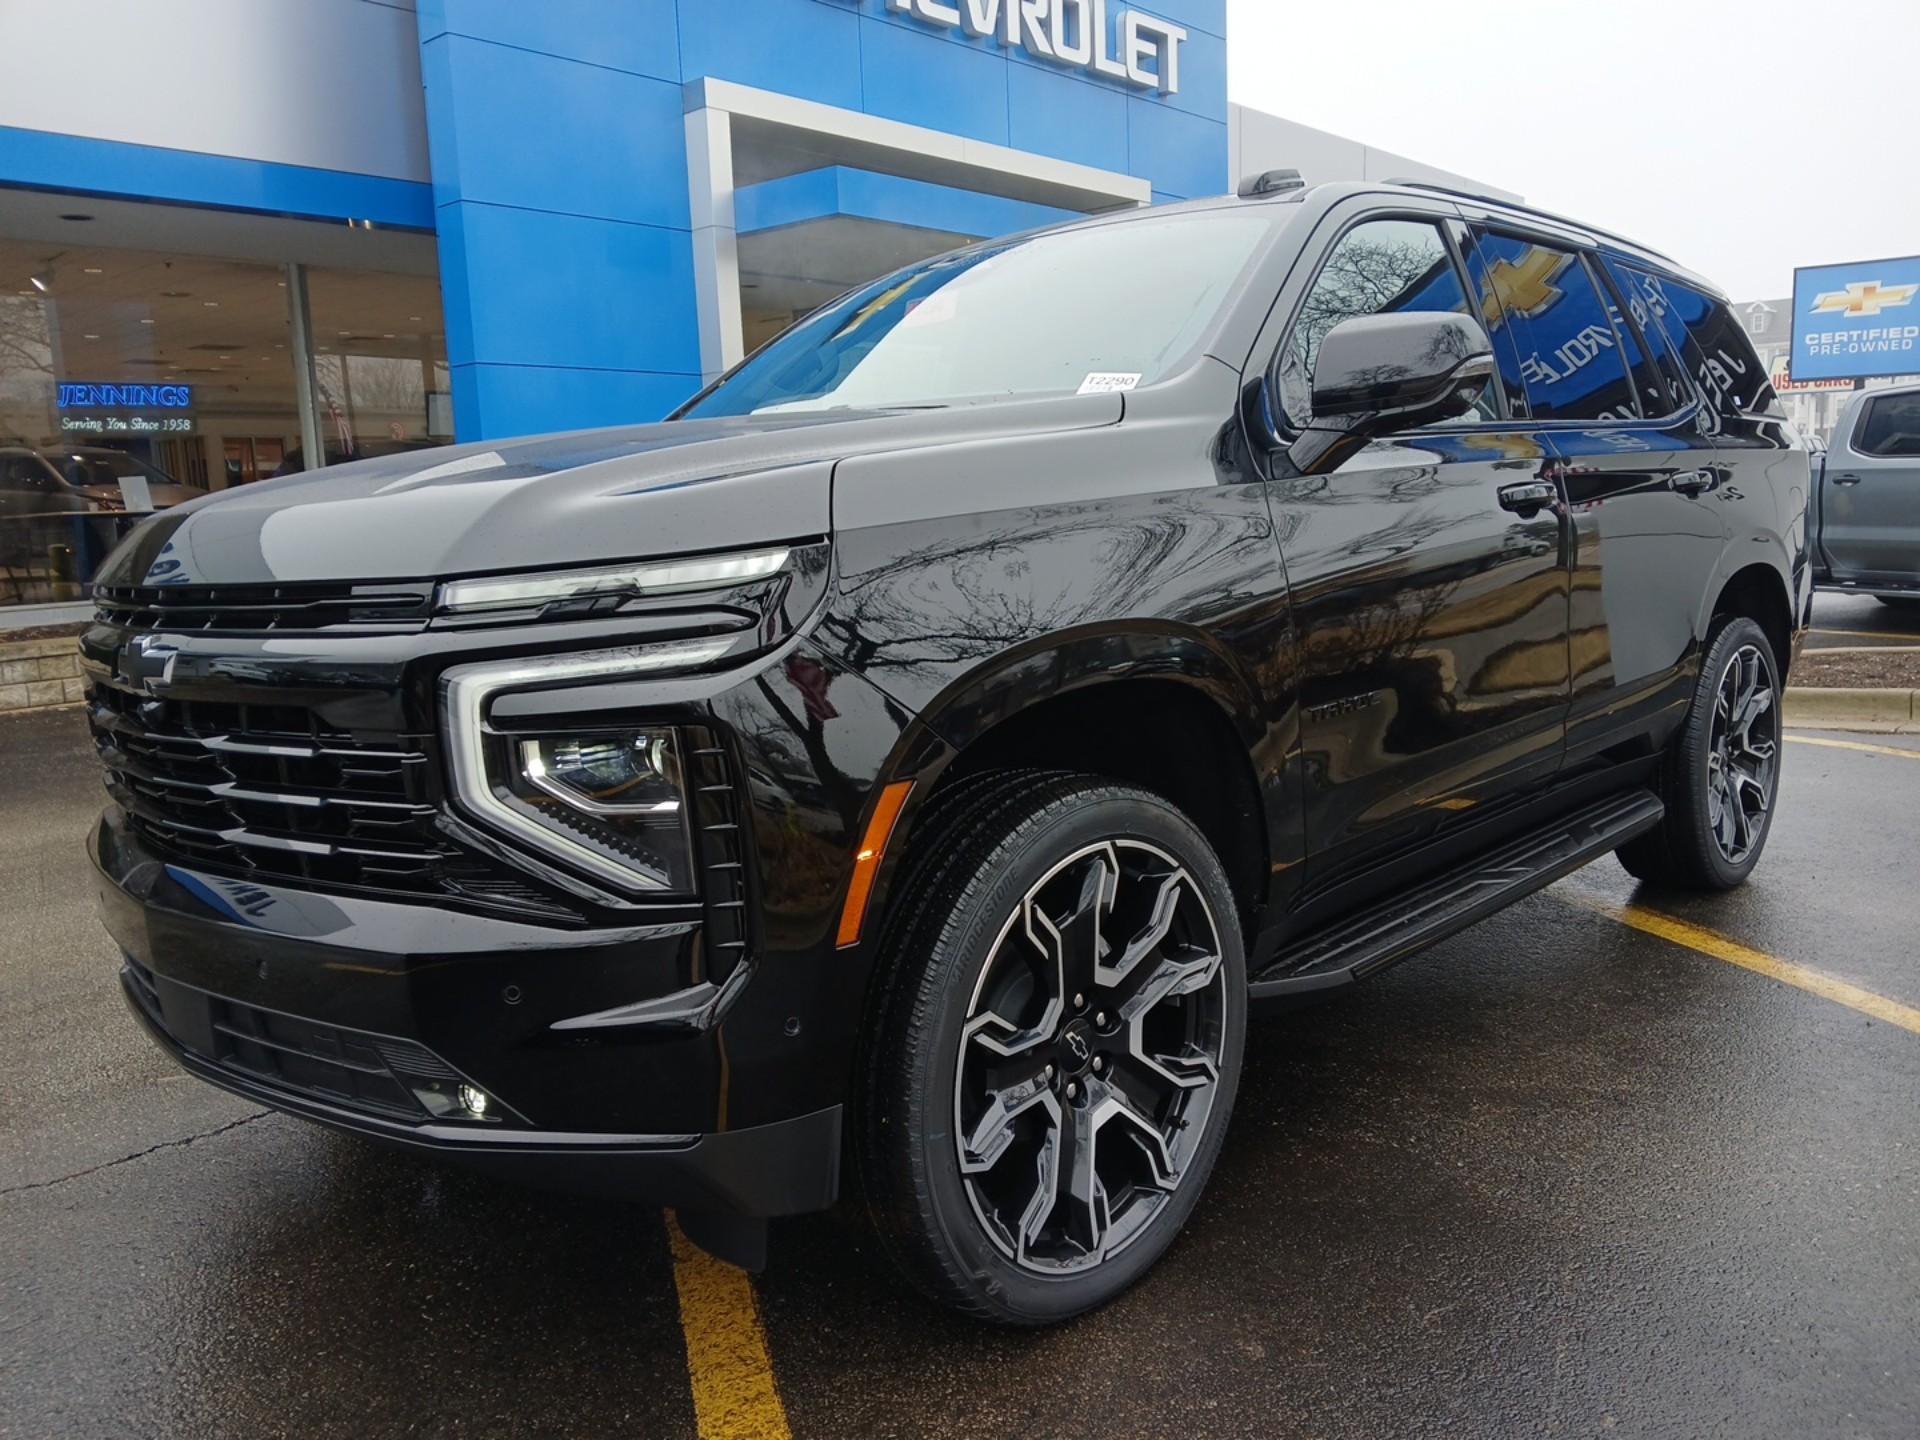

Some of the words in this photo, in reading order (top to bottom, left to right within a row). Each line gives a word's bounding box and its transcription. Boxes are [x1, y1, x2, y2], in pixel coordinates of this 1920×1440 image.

[887, 0, 1187, 96] VROLET
[1805, 326, 1919, 345] CERTIFIED
[1809, 339, 1913, 356] PRE-OWNED
[1088, 376, 1135, 386] T2290
[57, 385, 189, 408] JENNINGS
[61, 417, 103, 432] Serving
[106, 417, 127, 431] You
[131, 417, 159, 431] Since
[162, 419, 191, 431] 1958
[953, 866, 1019, 985] BRIDGESTONE
